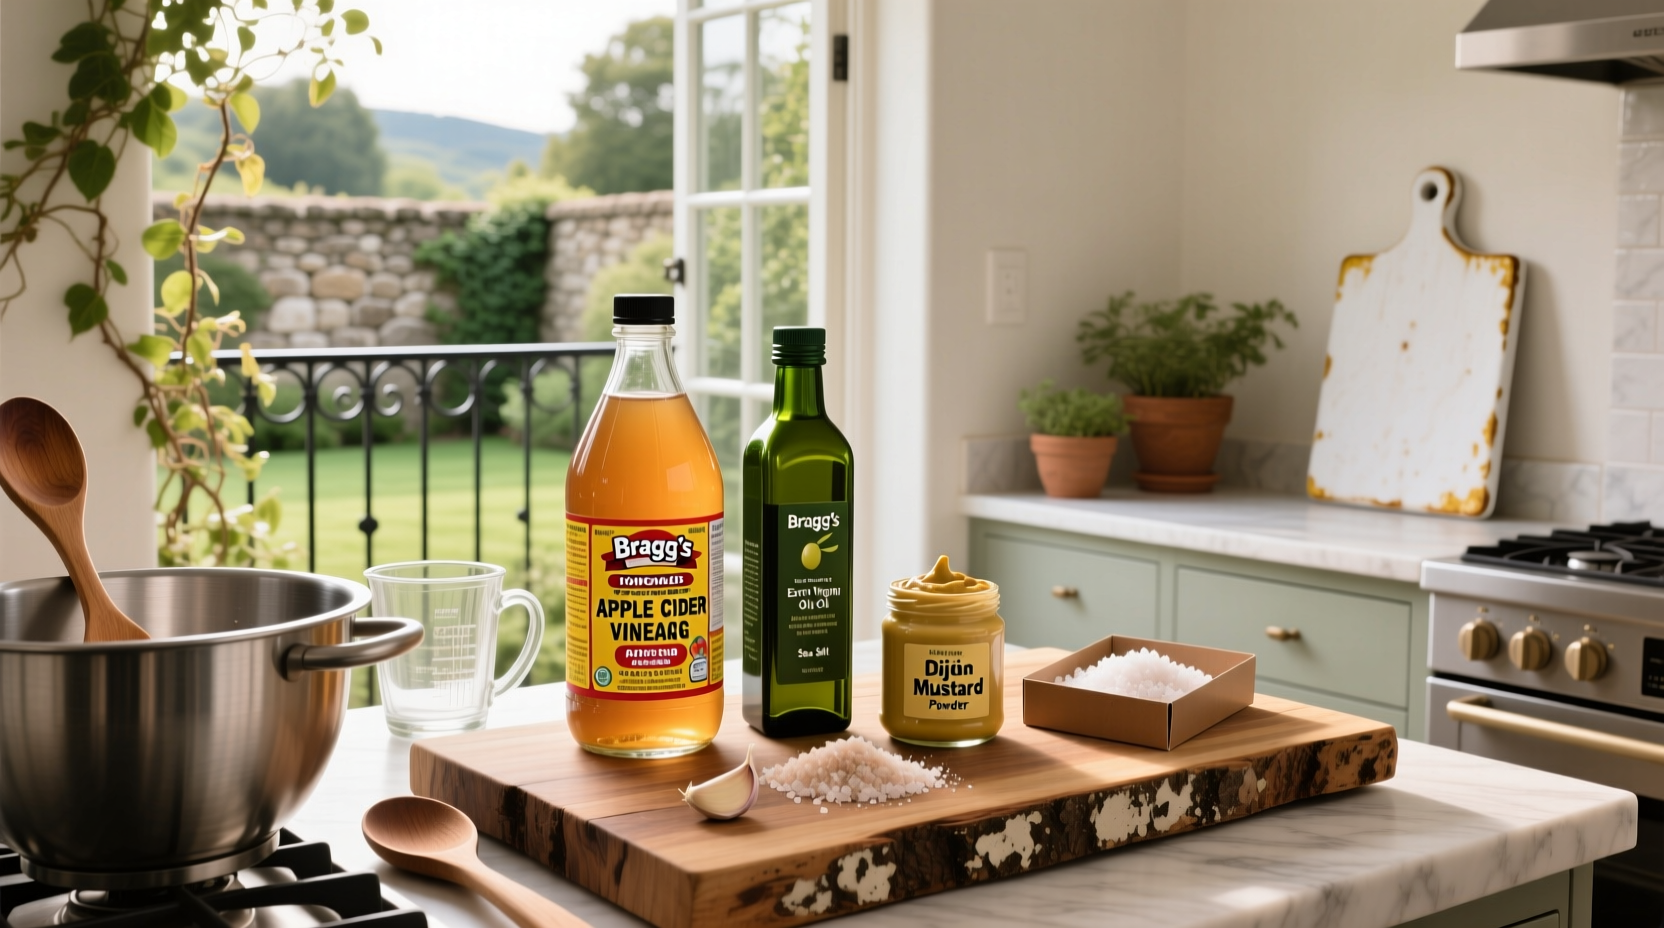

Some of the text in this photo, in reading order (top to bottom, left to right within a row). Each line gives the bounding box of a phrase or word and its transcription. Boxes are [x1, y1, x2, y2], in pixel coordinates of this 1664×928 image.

[788, 512, 840, 532] Bragg's
[614, 537, 692, 562] Bragg's
[596, 596, 707, 619] APPLE CIDER
[914, 677, 984, 697] Mustard
